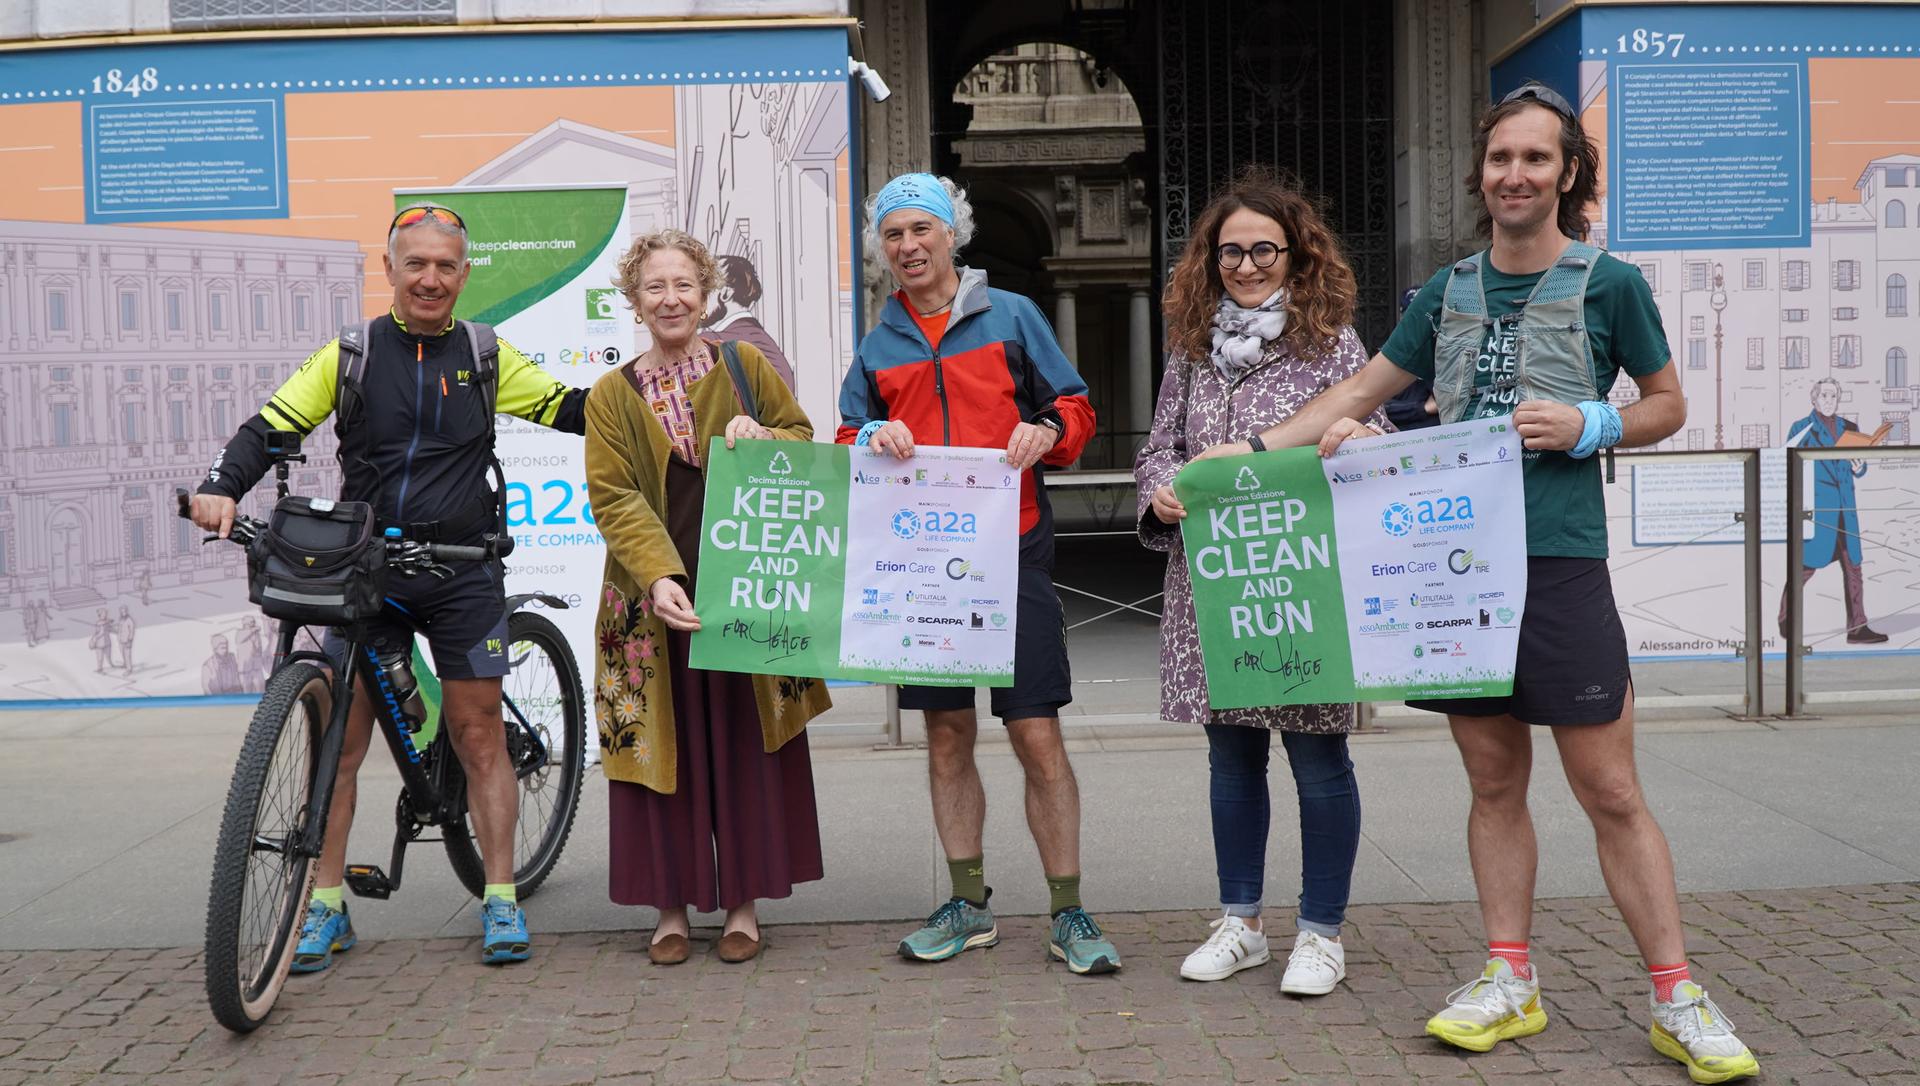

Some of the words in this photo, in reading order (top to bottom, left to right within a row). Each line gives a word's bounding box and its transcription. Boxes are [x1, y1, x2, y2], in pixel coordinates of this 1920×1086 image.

[1616, 28, 1685, 58] 1857
[92, 67, 158, 97] 1848
[1487, 336, 1515, 354] KE
[1476, 354, 1515, 372] CLE
[497, 455, 568, 467] NSPONSOR
[748, 476, 776, 485] Decima
[778, 477, 810, 487] Edizione
[732, 486, 825, 521] KEEP
[1218, 494, 1249, 504] Decima
[1251, 489, 1286, 501] Edizione
[1417, 495, 1474, 524] a2a
[924, 511, 977, 534] a2a
[1208, 498, 1307, 541] KEEP
[1419, 527, 1435, 535] LIFE
[1436, 522, 1475, 533] COMPANY
[514, 535, 533, 547] IFE
[538, 533, 606, 547] COMPAN
[710, 519, 840, 557] CLEAN
[747, 556, 799, 576] AND
[1196, 534, 1331, 580] CLEAN
[875, 561, 906, 573] Erion
[909, 562, 936, 574] Care
[1371, 564, 1405, 577] Erion
[1407, 562, 1437, 574] Care
[1475, 565, 1490, 574] TIRE
[729, 577, 811, 612] RUN
[1241, 576, 1293, 600] AND
[1478, 591, 1505, 599] RICREA
[1420, 594, 1454, 602] UTILITALIA
[917, 616, 963, 625] SCARPA
[1229, 599, 1314, 639] RUN
[1427, 618, 1472, 629] SCARPA
[722, 618, 748, 639] FOR
[1639, 639, 1714, 652] Alessandro
[1718, 637, 1775, 649] Manni
[1234, 650, 1259, 673] FOR
[890, 675, 973, 684] www.keepcleanandrun.com
[1586, 693, 1609, 701] SPORT
